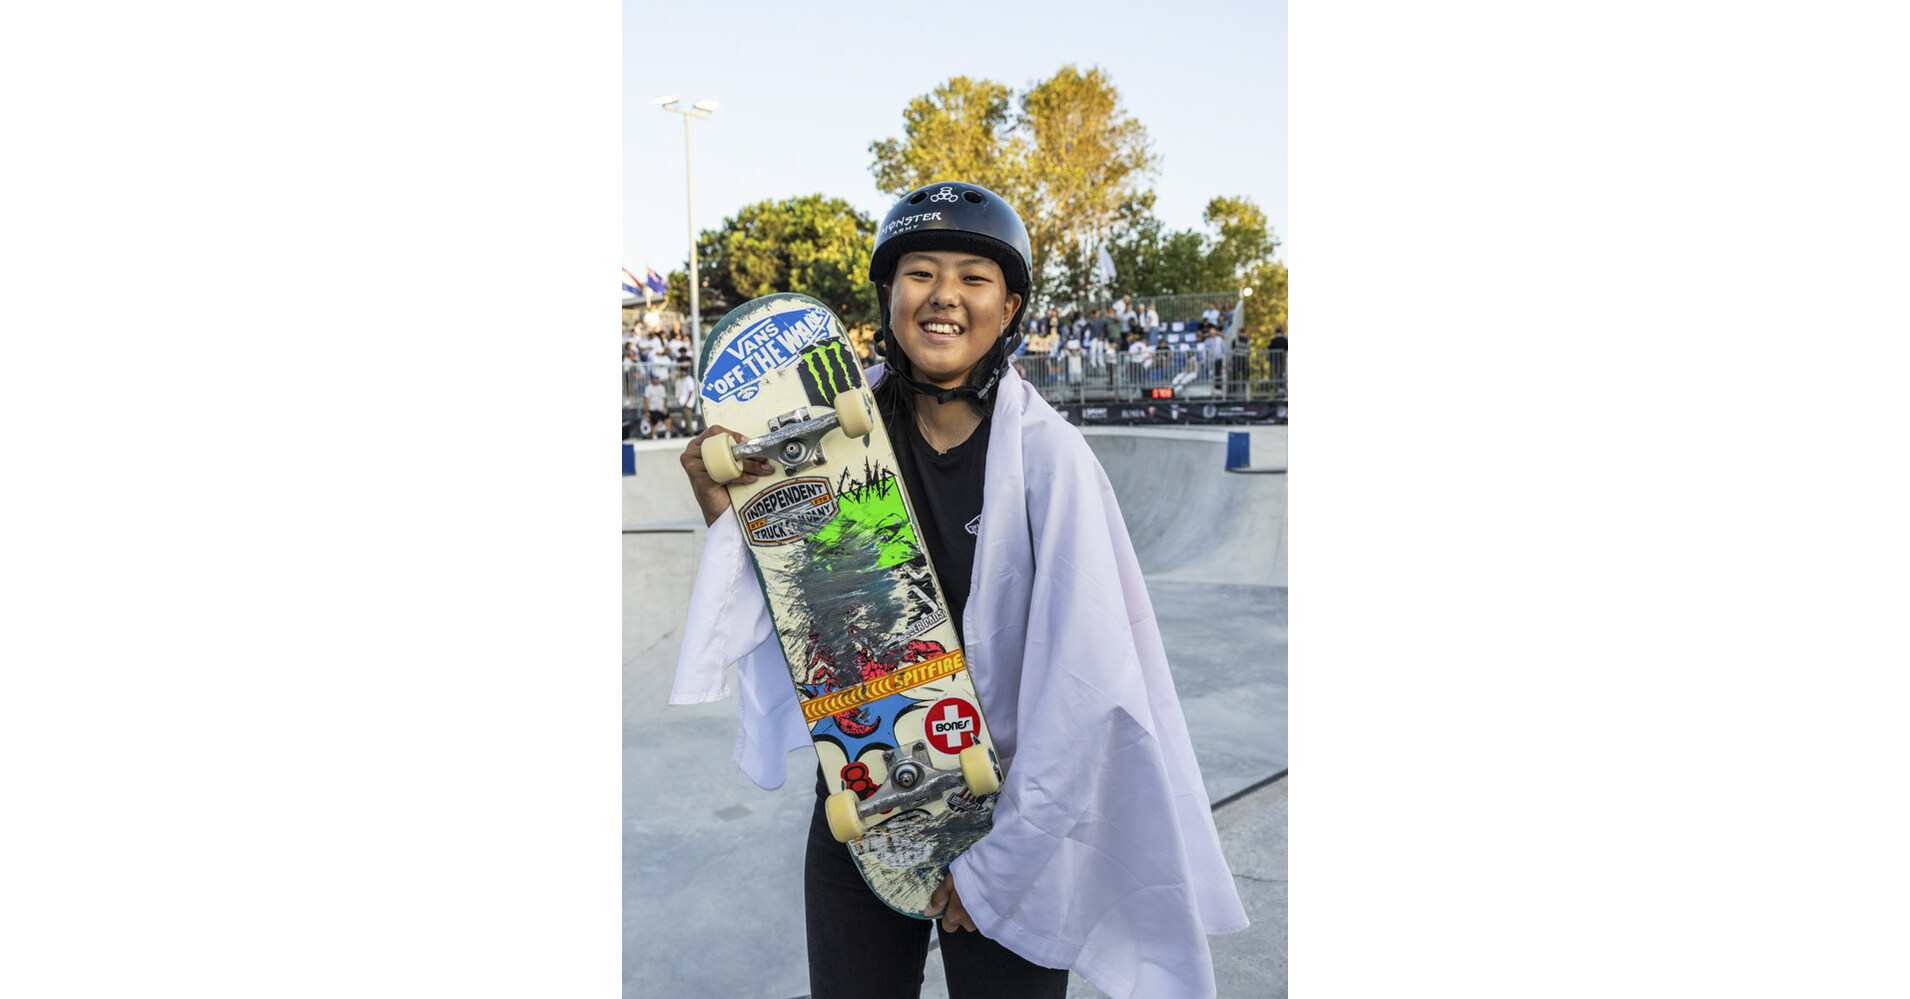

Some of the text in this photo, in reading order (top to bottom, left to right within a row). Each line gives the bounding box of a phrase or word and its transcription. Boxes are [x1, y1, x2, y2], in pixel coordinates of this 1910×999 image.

[892, 224, 919, 236] ARMY
[726, 318, 780, 360] VANS
[742, 340, 787, 377] THE
[747, 484, 823, 520] INDEPENDENT
[754, 523, 787, 539] TRUCK
[894, 656, 963, 688] SPITFIRE
[936, 720, 970, 732] BONES
